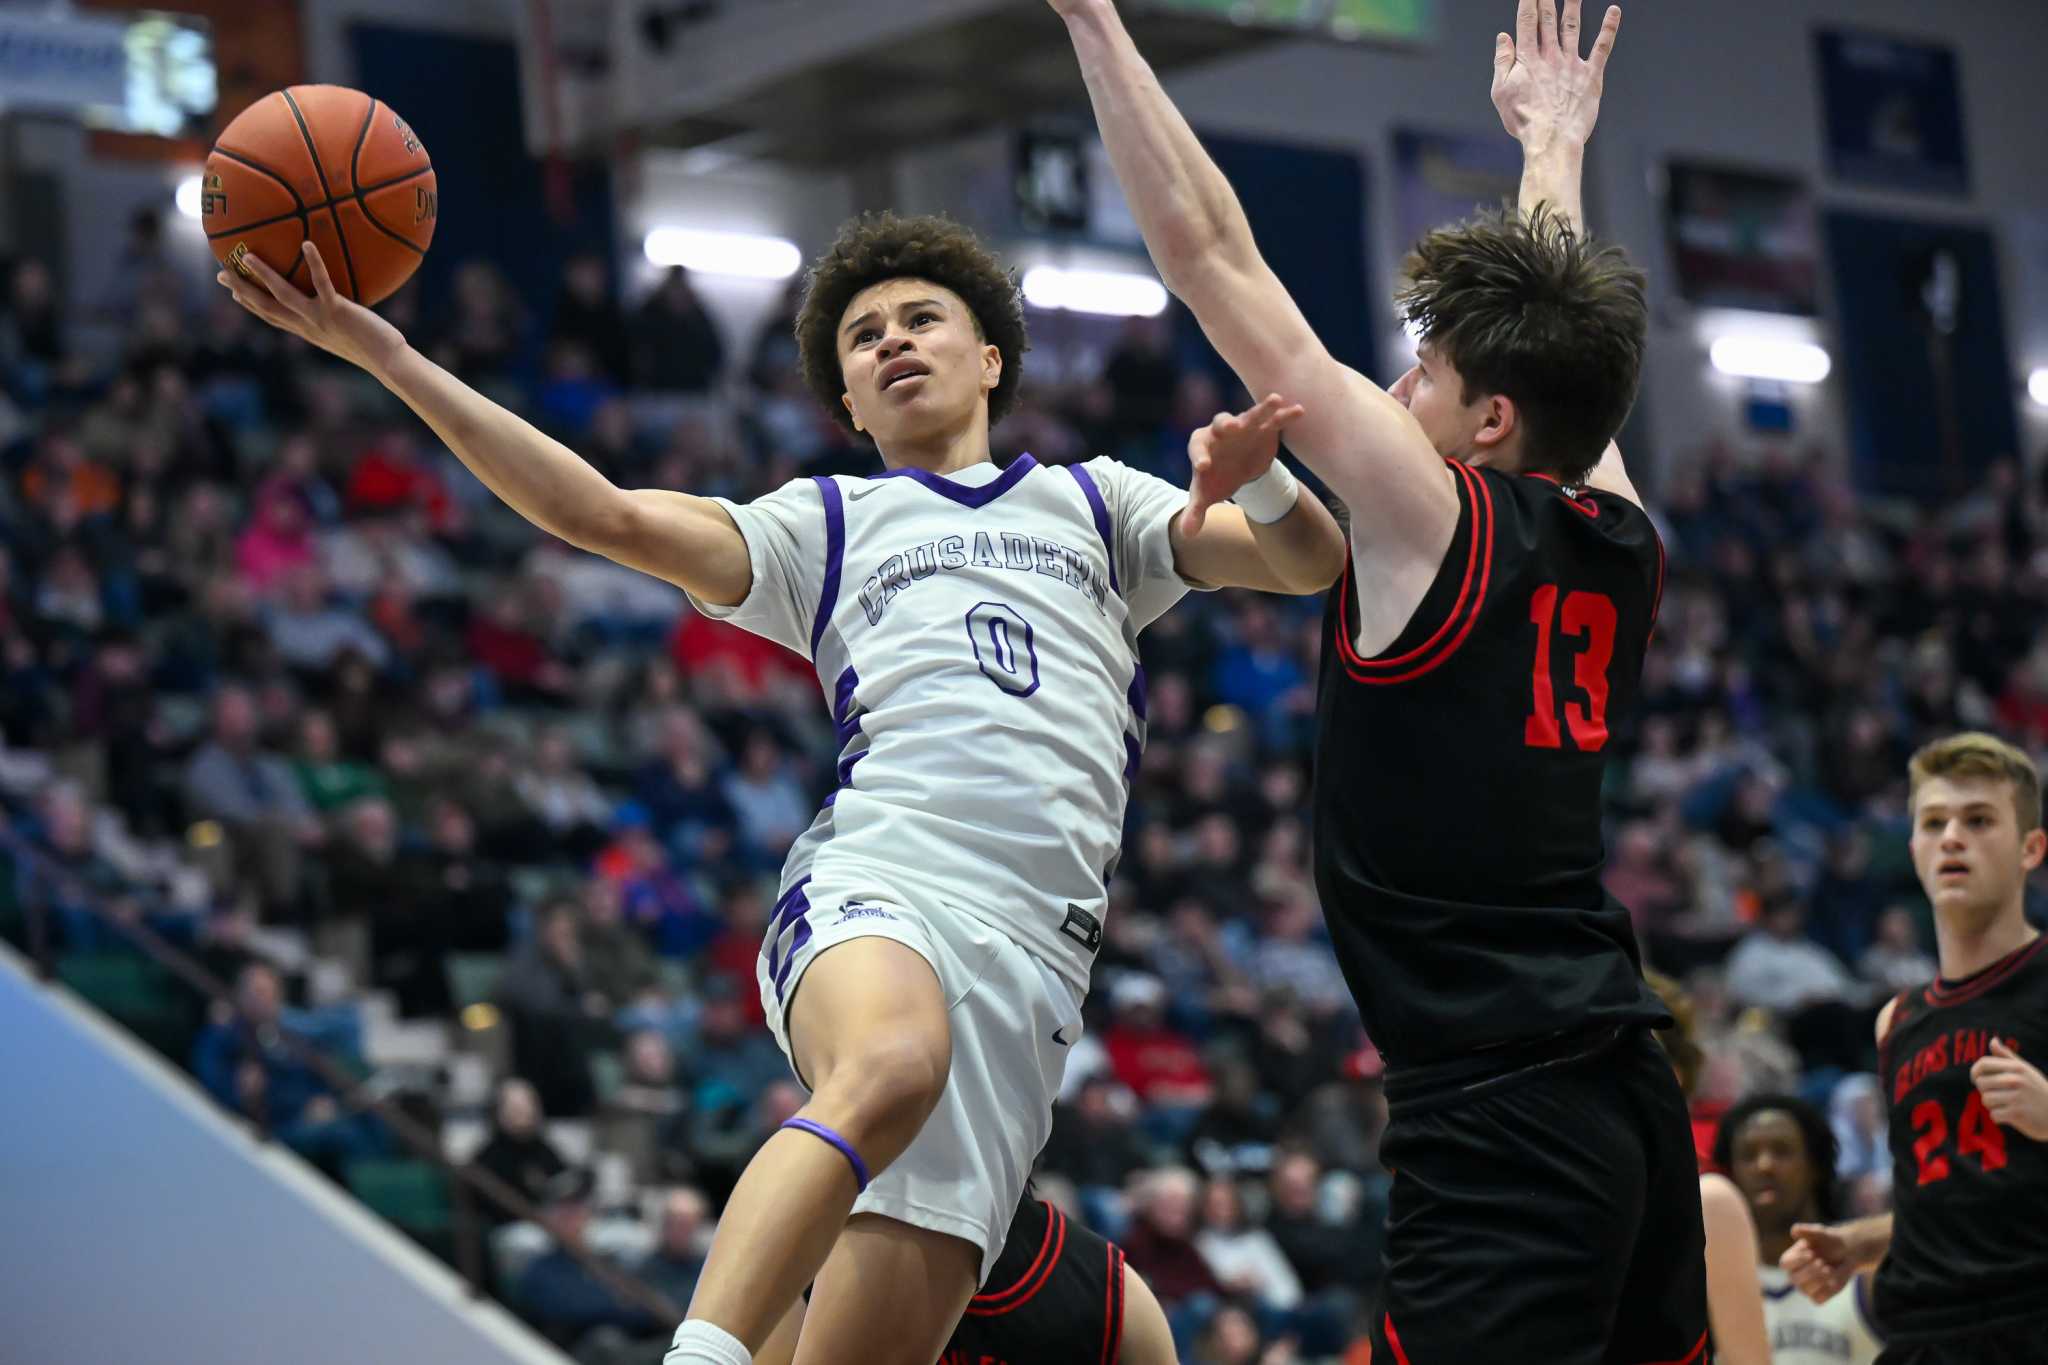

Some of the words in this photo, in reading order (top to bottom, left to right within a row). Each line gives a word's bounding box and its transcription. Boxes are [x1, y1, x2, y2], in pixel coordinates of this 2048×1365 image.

[965, 601, 1040, 698] 0
[1524, 583, 1618, 752] 13
[1911, 1090, 2008, 1186] 24
